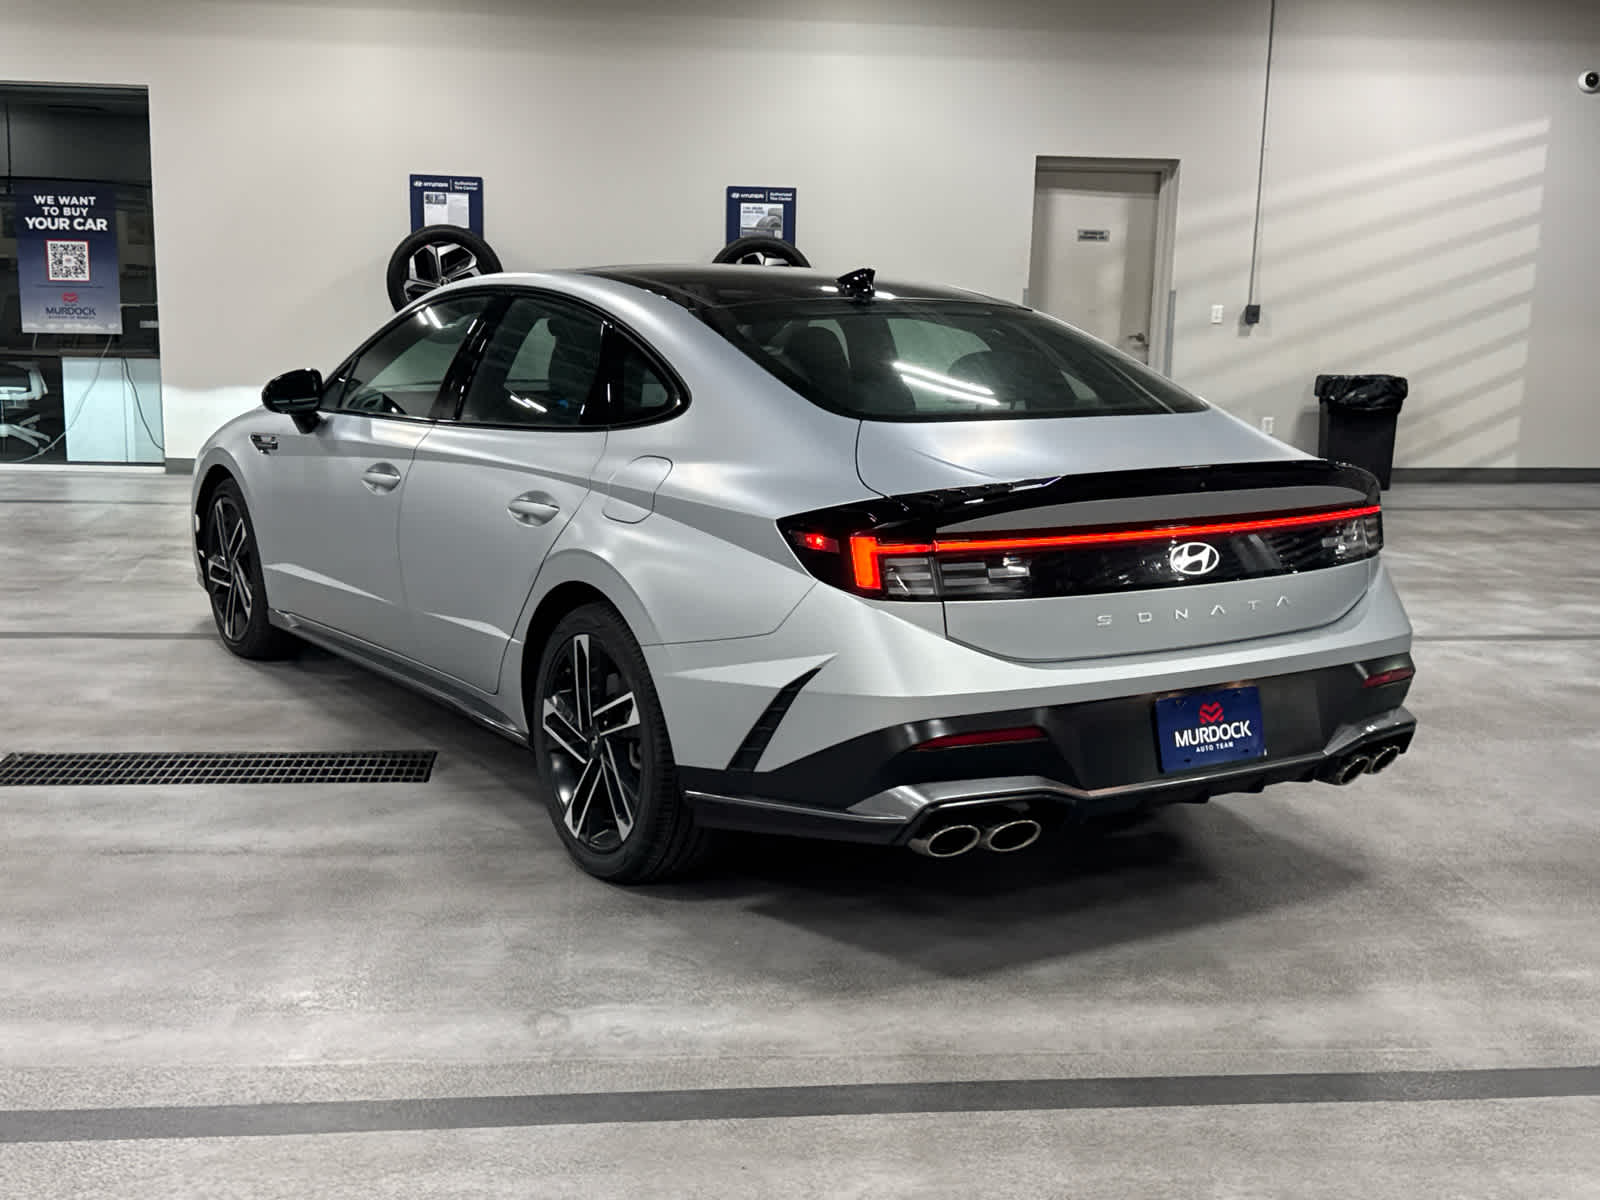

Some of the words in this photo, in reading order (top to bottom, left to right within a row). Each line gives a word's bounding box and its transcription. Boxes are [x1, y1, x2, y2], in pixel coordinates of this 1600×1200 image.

[33, 195, 55, 205] WE
[58, 196, 97, 206] WANT
[42, 206, 60, 216] TO
[63, 207, 89, 217] BUY
[25, 217, 70, 231] YOUR
[73, 218, 108, 231] CAR
[45, 306, 97, 316] MURDOCK
[1096, 595, 1290, 626] SONATA
[1174, 720, 1252, 748] MURDOCK
[1195, 745, 1214, 753] AUTO
[1216, 741, 1234, 750] TEAM
